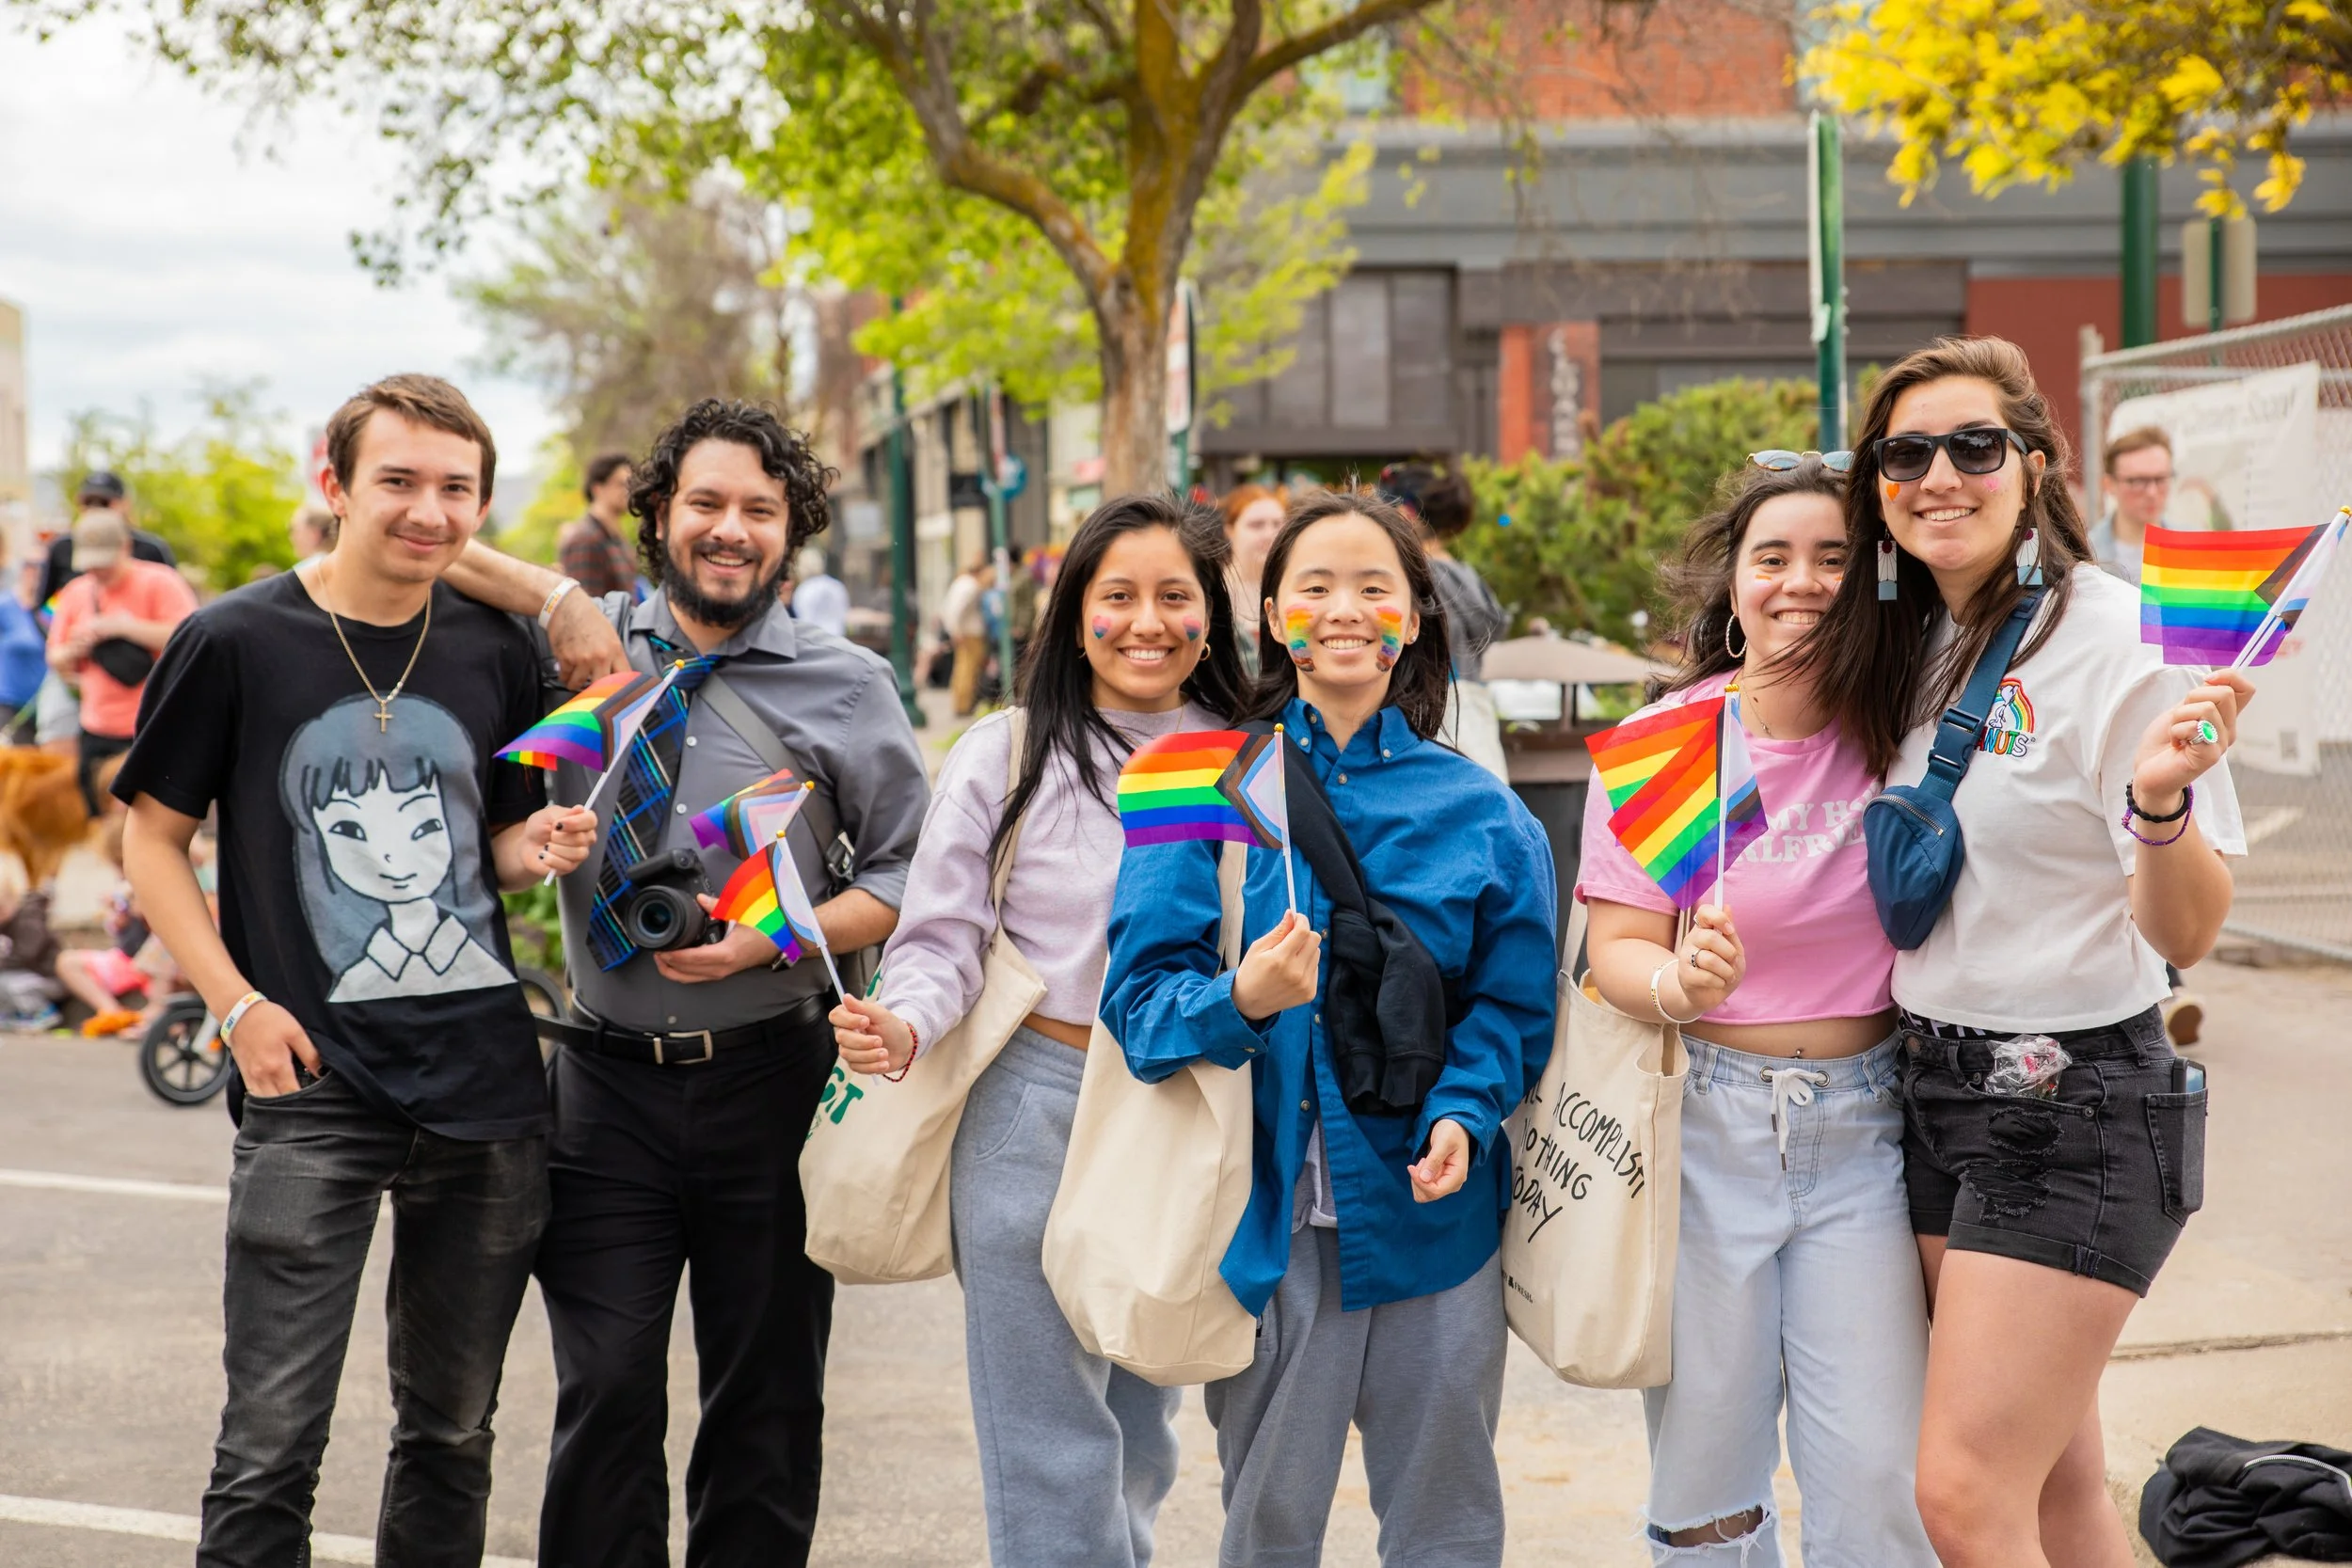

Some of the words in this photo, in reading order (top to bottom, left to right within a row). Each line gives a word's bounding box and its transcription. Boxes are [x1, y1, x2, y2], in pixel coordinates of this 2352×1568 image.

[1974, 726, 2029, 757] ANUTS
[1521, 1117, 1593, 1200] NOTHING
[1513, 1165, 1564, 1243] TODAY
